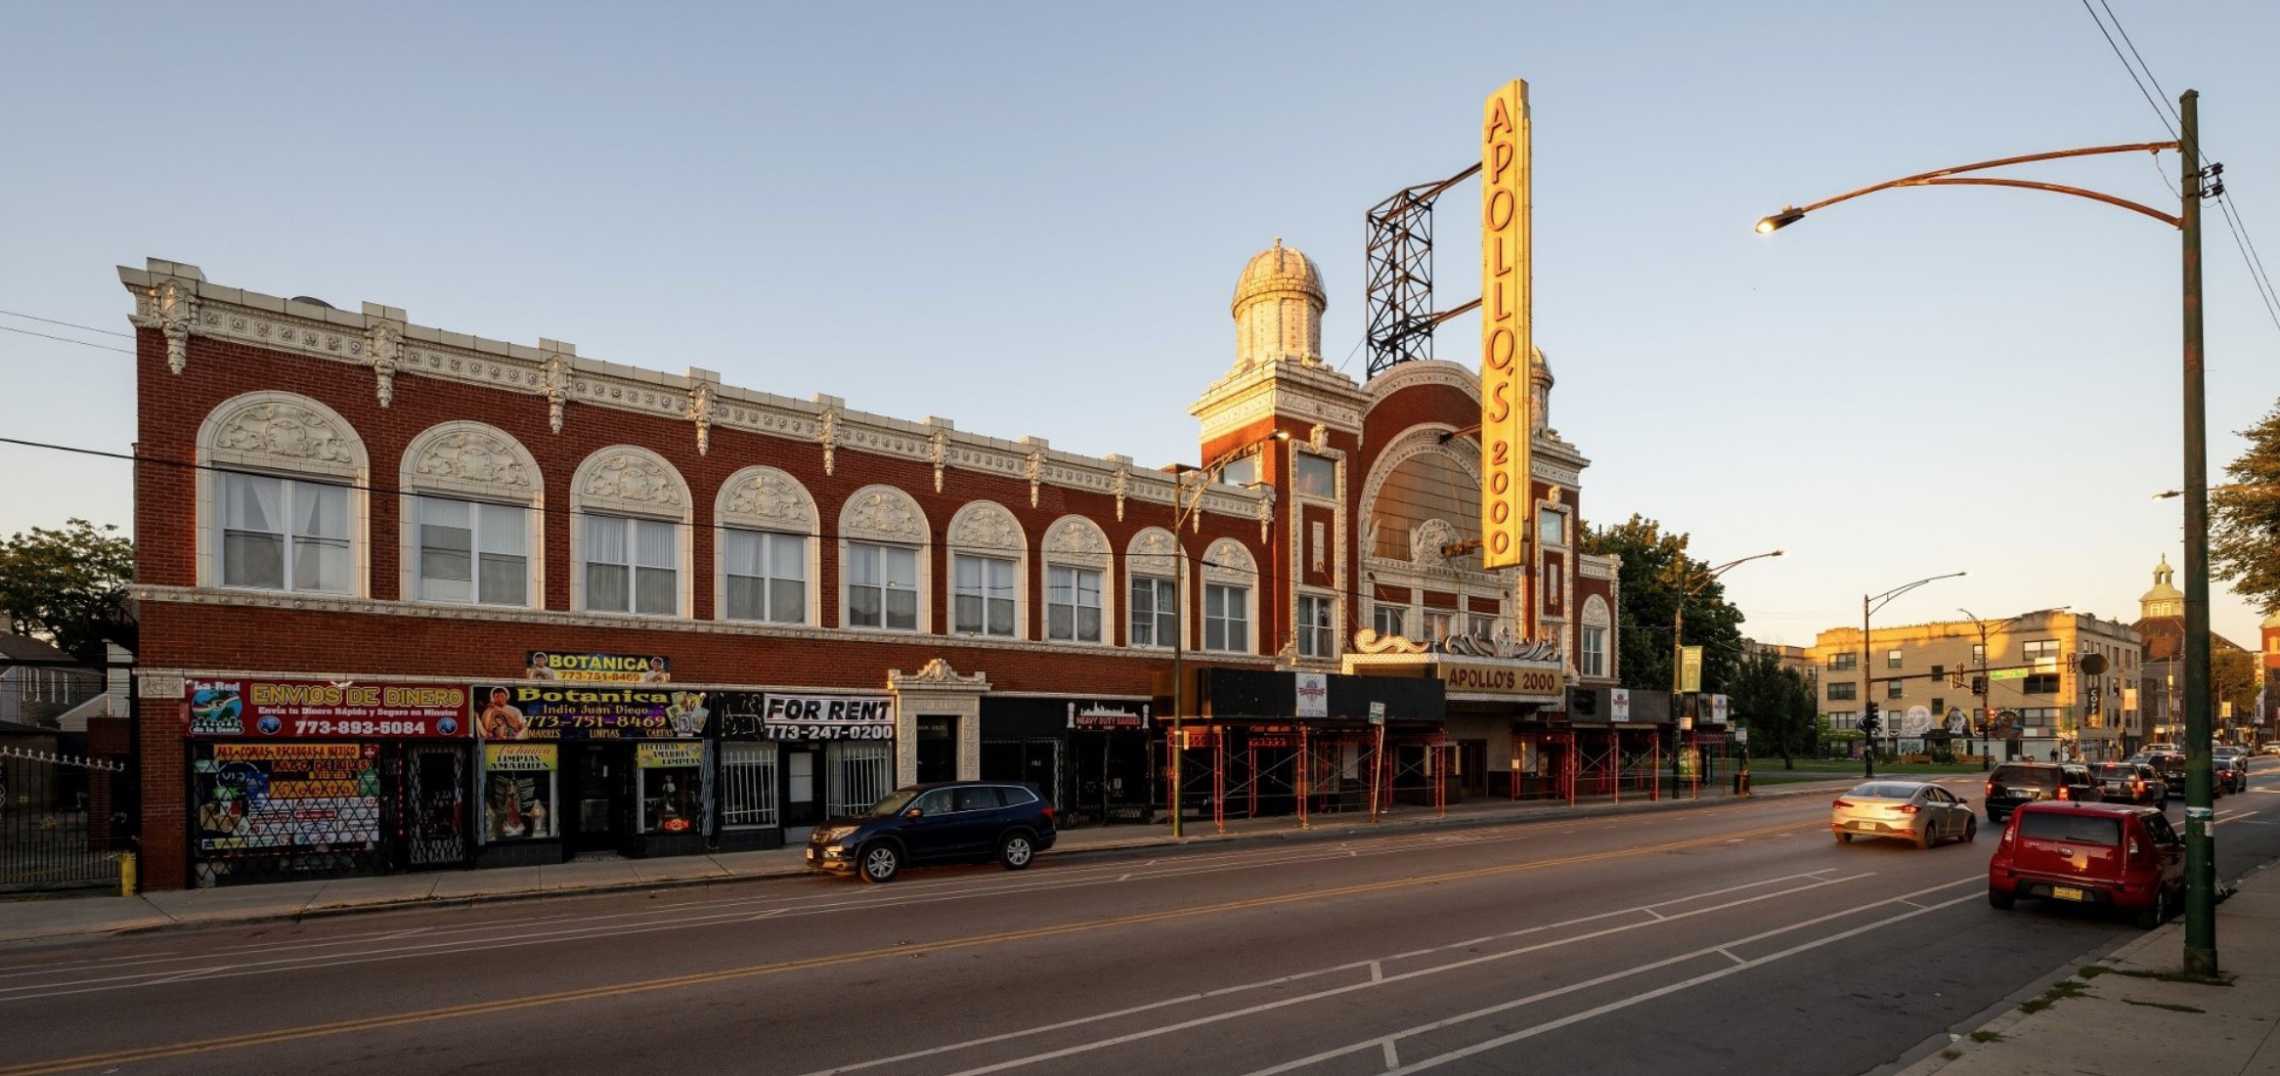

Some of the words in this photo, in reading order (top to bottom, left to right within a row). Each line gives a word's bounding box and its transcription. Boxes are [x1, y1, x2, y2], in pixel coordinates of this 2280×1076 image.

[1485, 97, 1514, 422] APOLLO'S
[1491, 440, 1509, 555] 2000
[549, 654, 649, 671] BOTANICA
[1449, 669, 1514, 689] APOLLO'S
[1523, 673, 1555, 690] 2000
[251, 683, 342, 705] ENVIOS
[347, 687, 380, 706] DE
[384, 687, 464, 708] DINERO
[517, 688, 668, 703] Botanica
[543, 704, 576, 714] Indio
[581, 704, 610, 714] Juan
[616, 705, 648, 716] Diego
[767, 699, 822, 719] FOR
[828, 701, 891, 720] RENT
[295, 720, 425, 734] 773-893-5084
[525, 716, 666, 728] 773-751-8469
[767, 725, 893, 740] 773-247-0200
